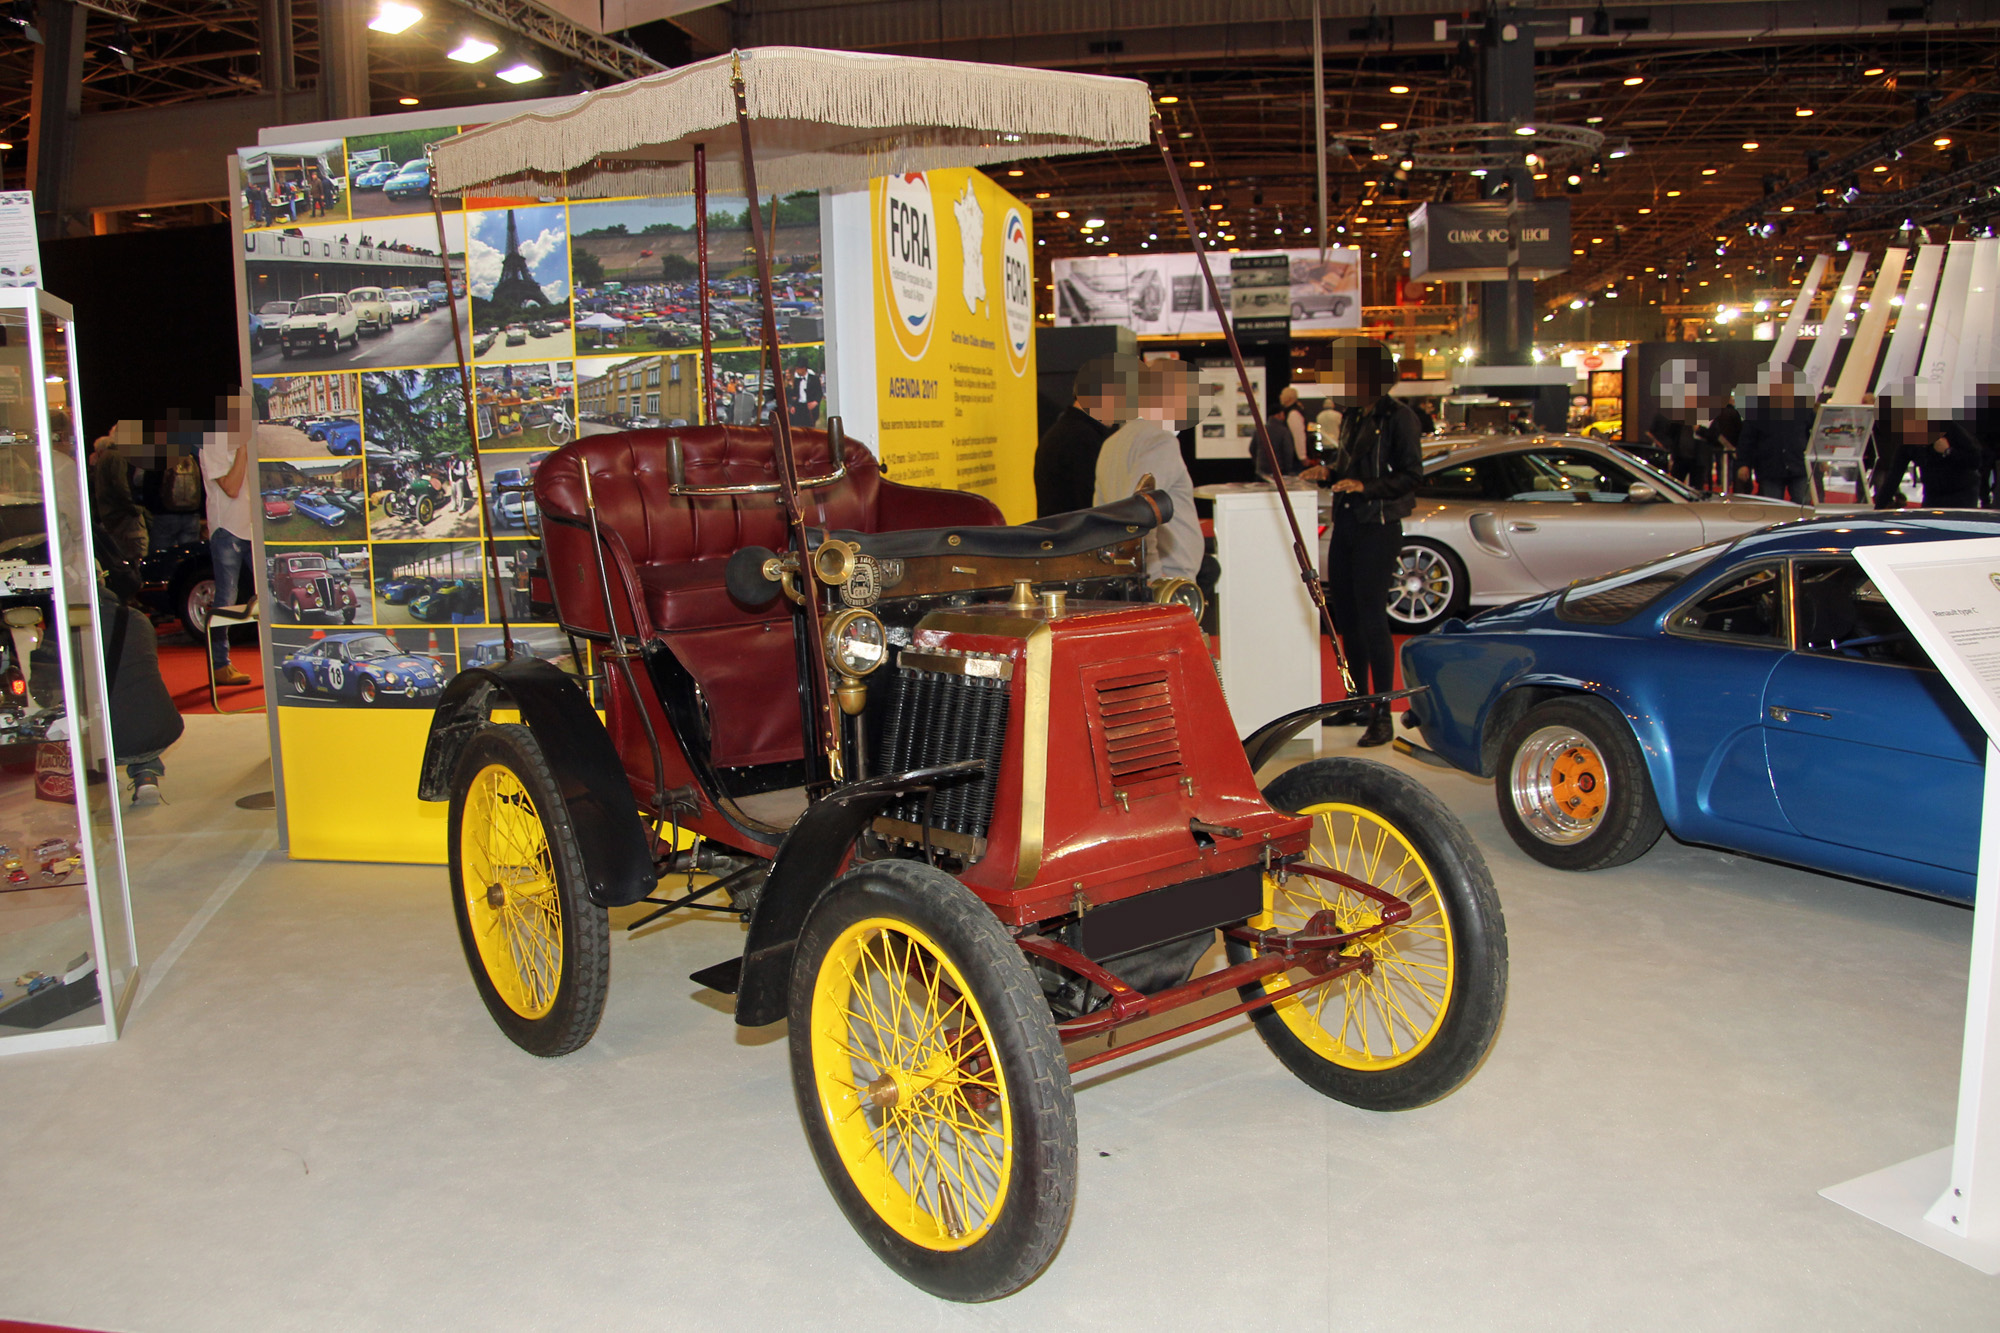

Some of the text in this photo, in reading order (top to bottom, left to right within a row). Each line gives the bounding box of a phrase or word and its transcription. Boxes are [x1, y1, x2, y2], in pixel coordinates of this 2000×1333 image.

[890, 197, 932, 270] FCRA
[1447, 229, 1484, 243] CLASSIC
[1487, 228, 1510, 243] SPO
[1006, 255, 1029, 307] FCRA
[889, 377, 921, 399] AGENDA
[922, 379, 938, 399] 2017
[854, 589, 867, 597] CAR
[1932, 608, 1958, 617] Renault
[1958, 608, 1972, 617] type
[330, 667, 342, 686] 18
